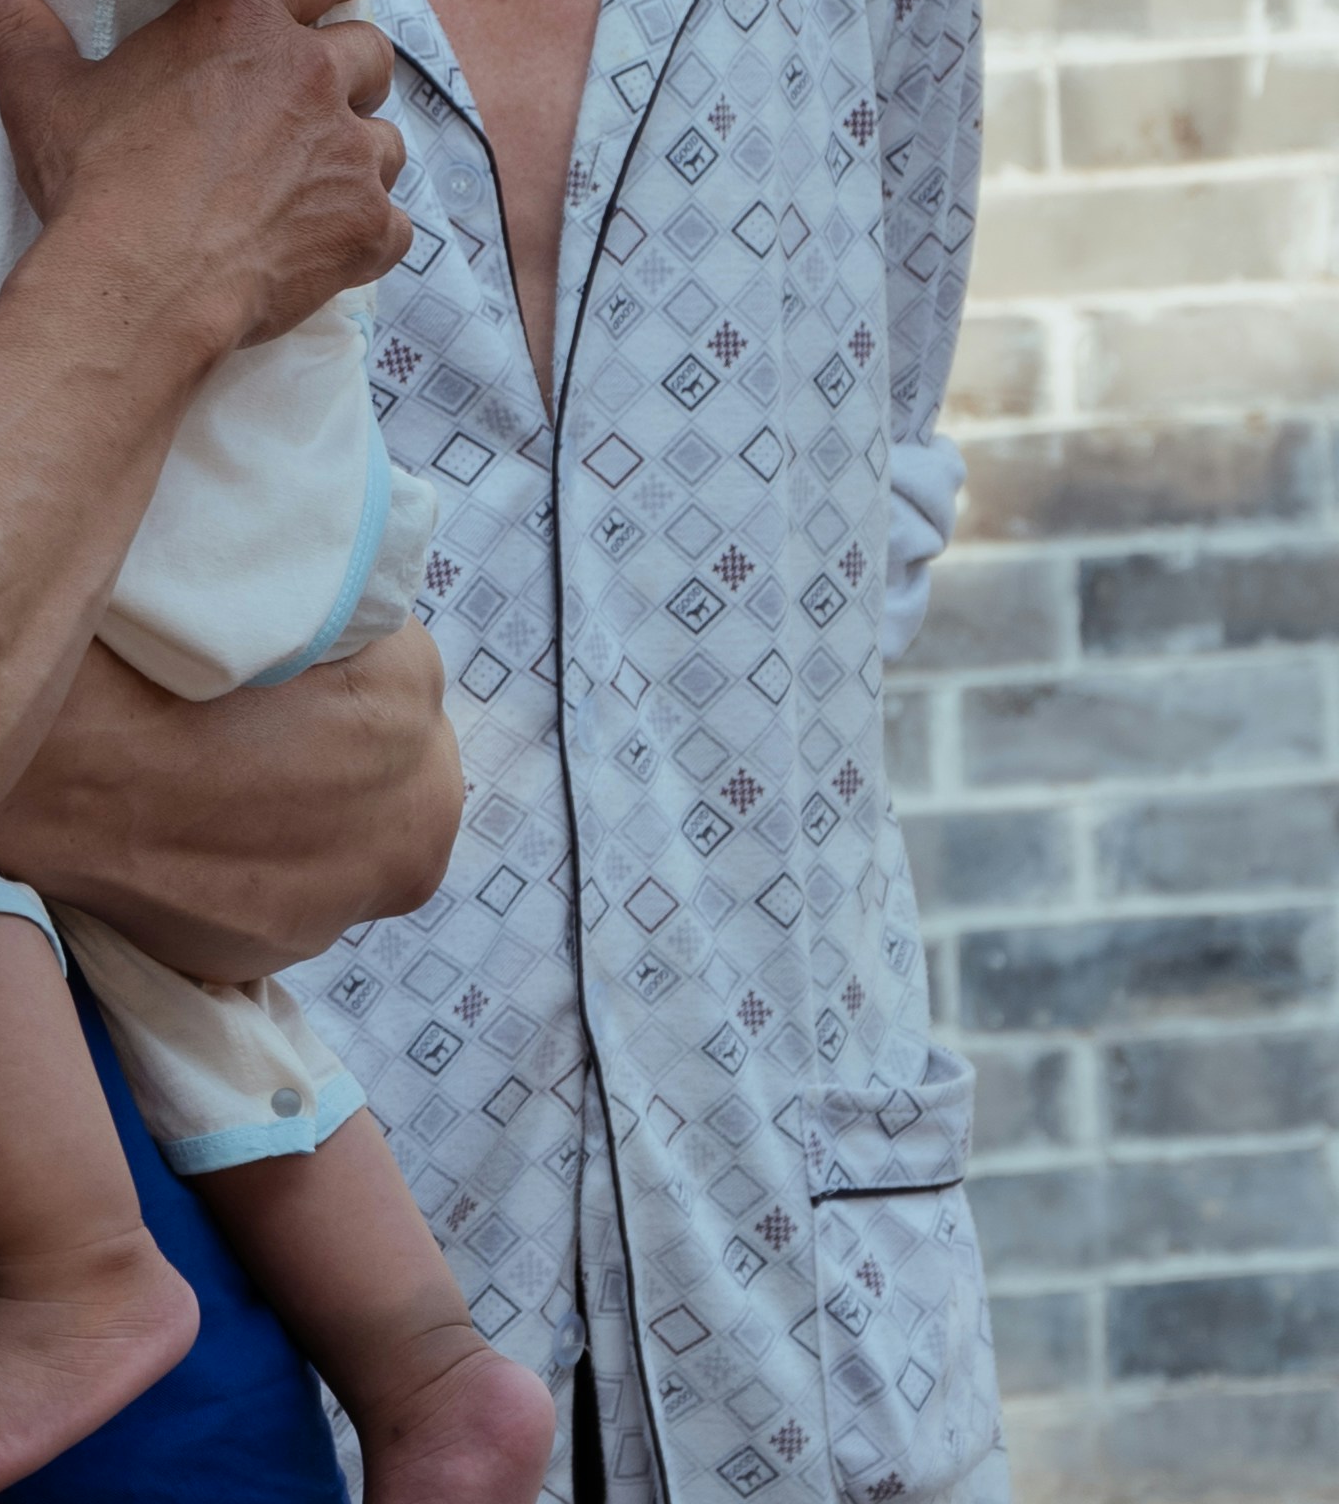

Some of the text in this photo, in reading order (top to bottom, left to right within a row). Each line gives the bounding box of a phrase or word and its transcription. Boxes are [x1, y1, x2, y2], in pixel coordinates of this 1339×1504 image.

[674, 135, 697, 163] GOOD
[672, 362, 696, 390] GOOD
[675, 587, 702, 614] GOOD
